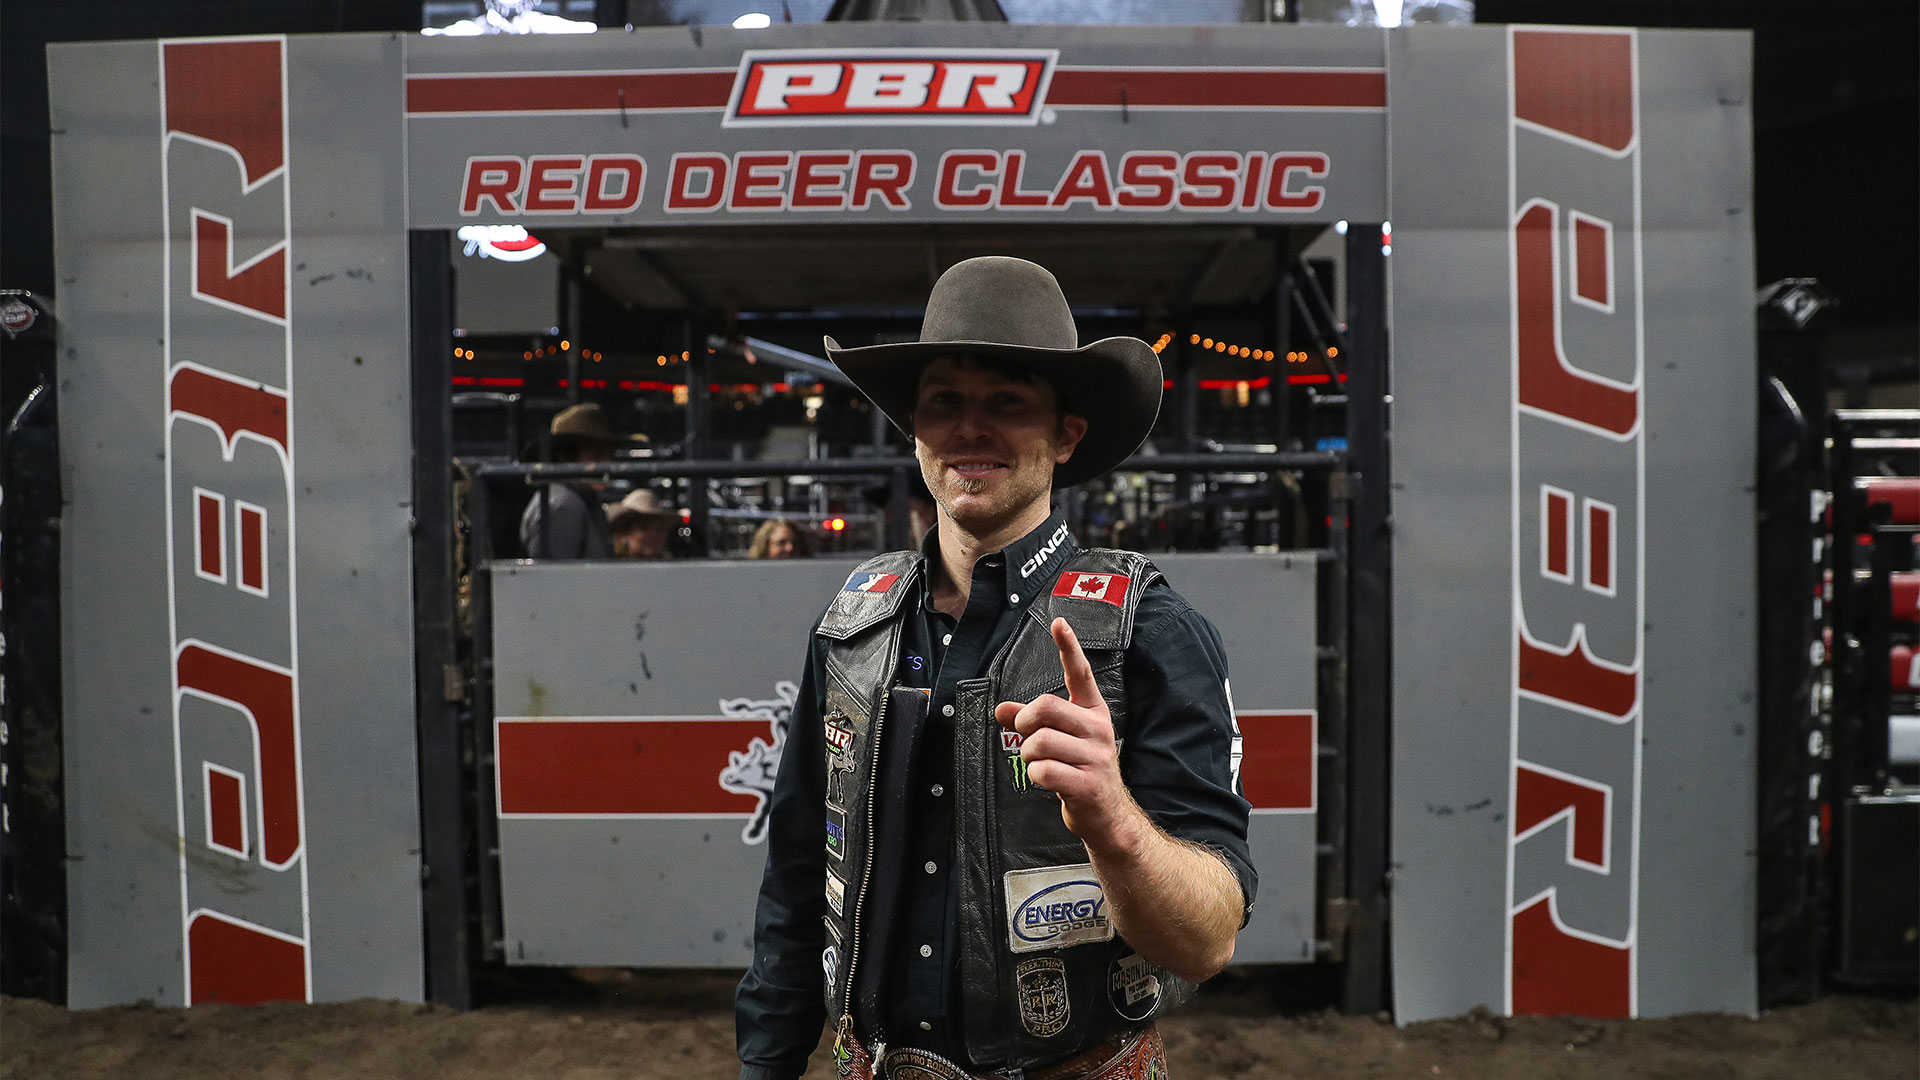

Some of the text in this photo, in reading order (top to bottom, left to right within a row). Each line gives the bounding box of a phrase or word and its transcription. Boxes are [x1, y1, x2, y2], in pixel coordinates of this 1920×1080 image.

[754, 63, 1028, 110] PBR
[460, 149, 1330, 216] RED DEER CLASSIC
[163, 131, 308, 945] PBR
[1506, 116, 1645, 950] PBR
[1024, 899, 1104, 925] ENERGY
[1047, 917, 1106, 934] DODGE
